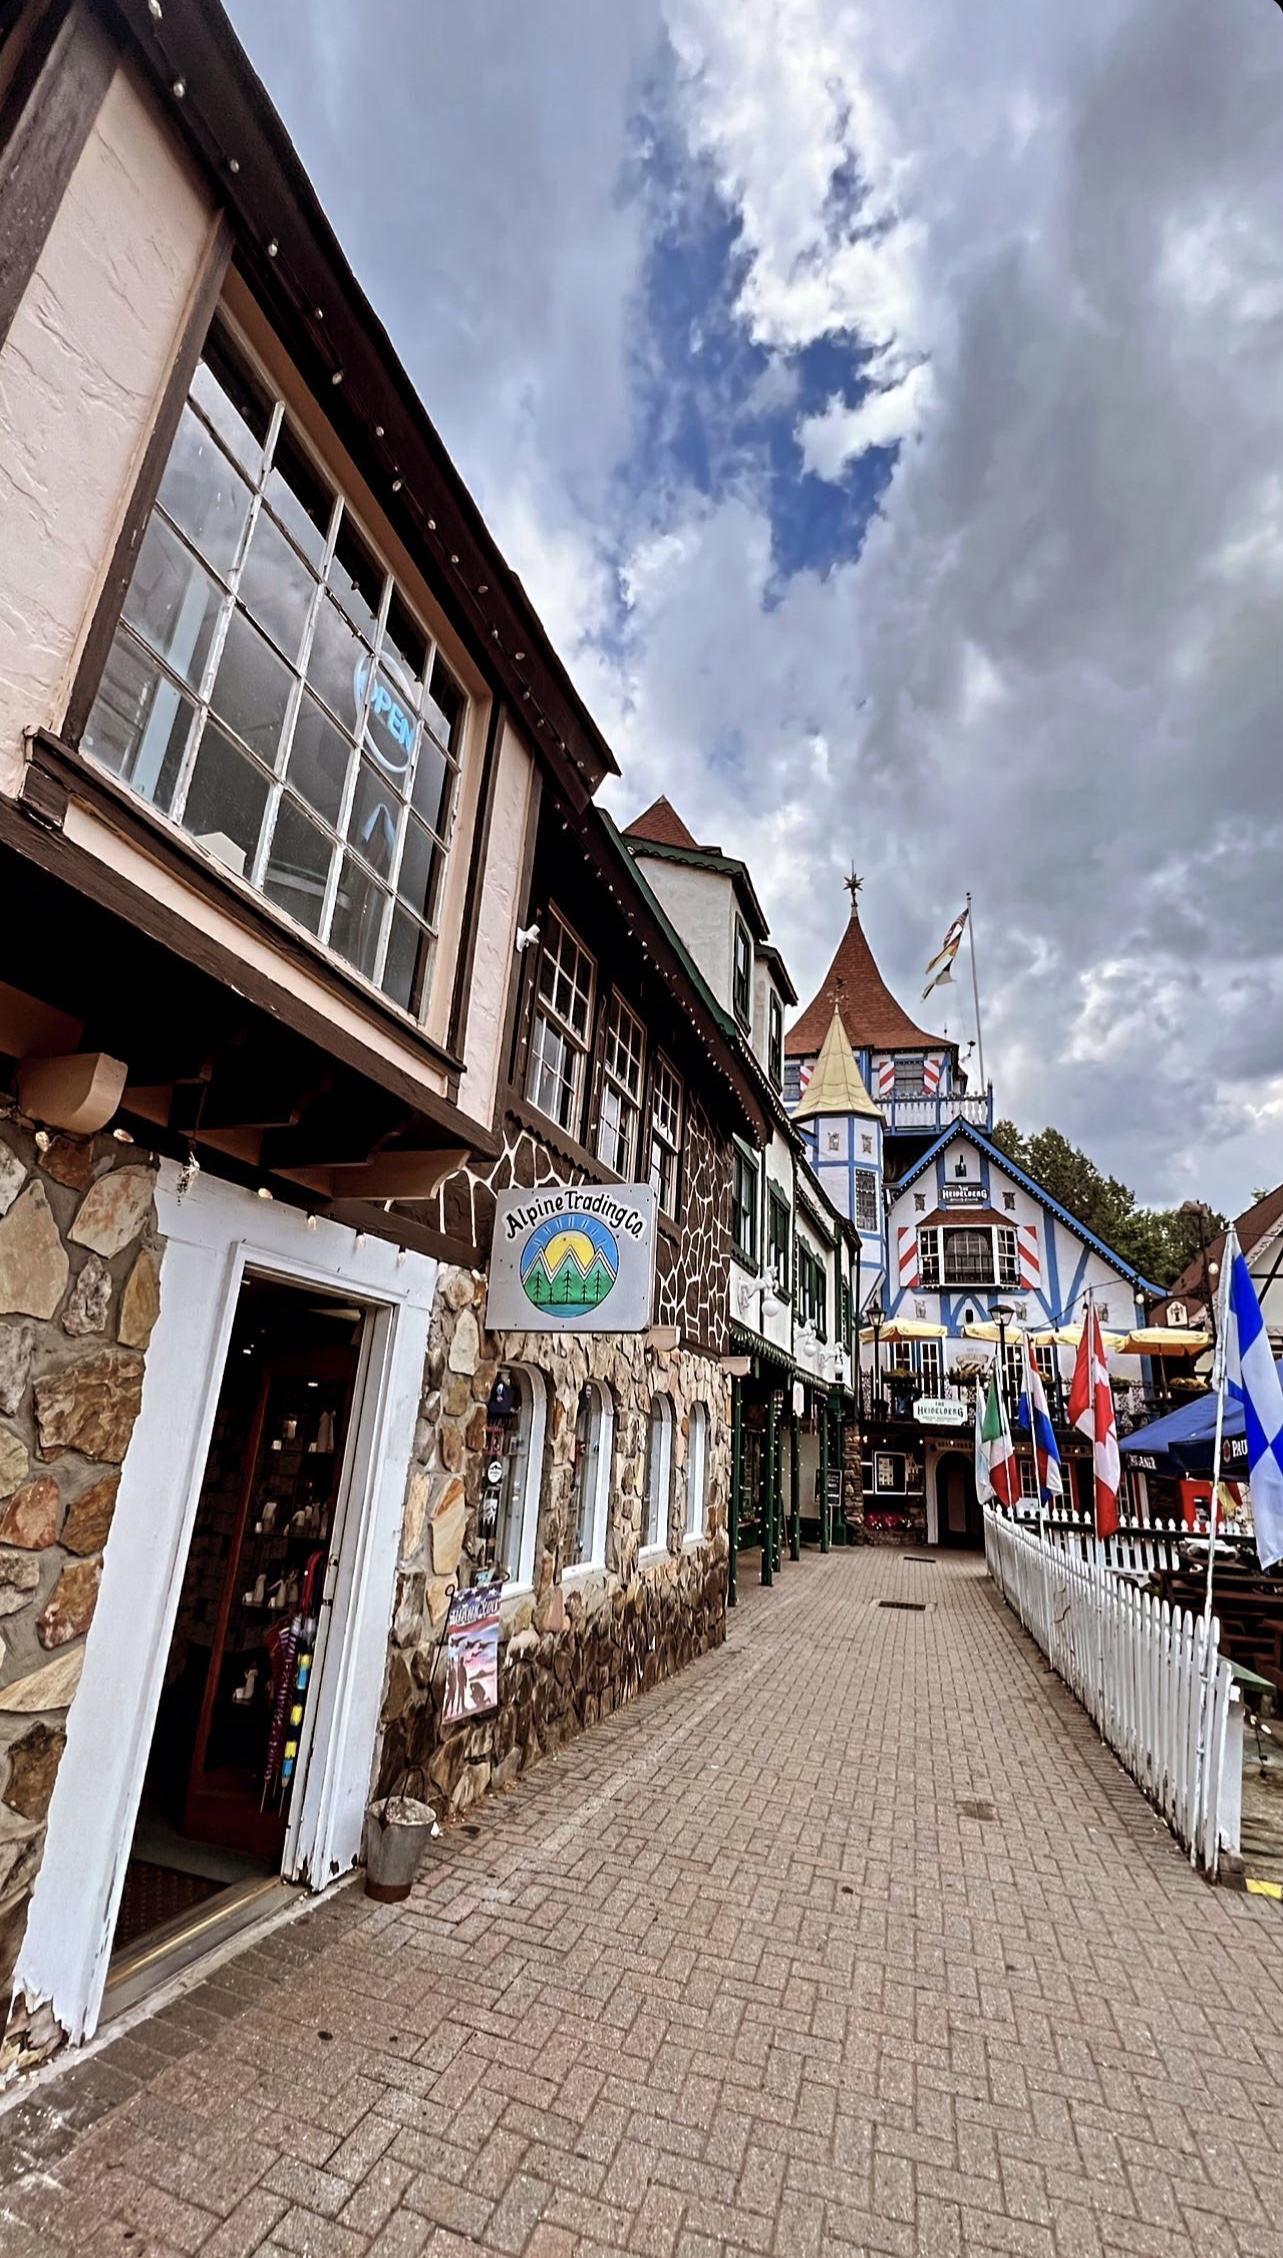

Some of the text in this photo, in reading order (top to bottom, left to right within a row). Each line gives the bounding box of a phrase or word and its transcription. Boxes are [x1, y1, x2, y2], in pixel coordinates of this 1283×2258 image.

[942, 1189, 988, 1200] HEIDELBERG
[506, 1190, 643, 1239] Alpine Trading Co.
[917, 1405, 964, 1418] HEIDELBERG
[451, 1597, 501, 1625] THANK YOU
